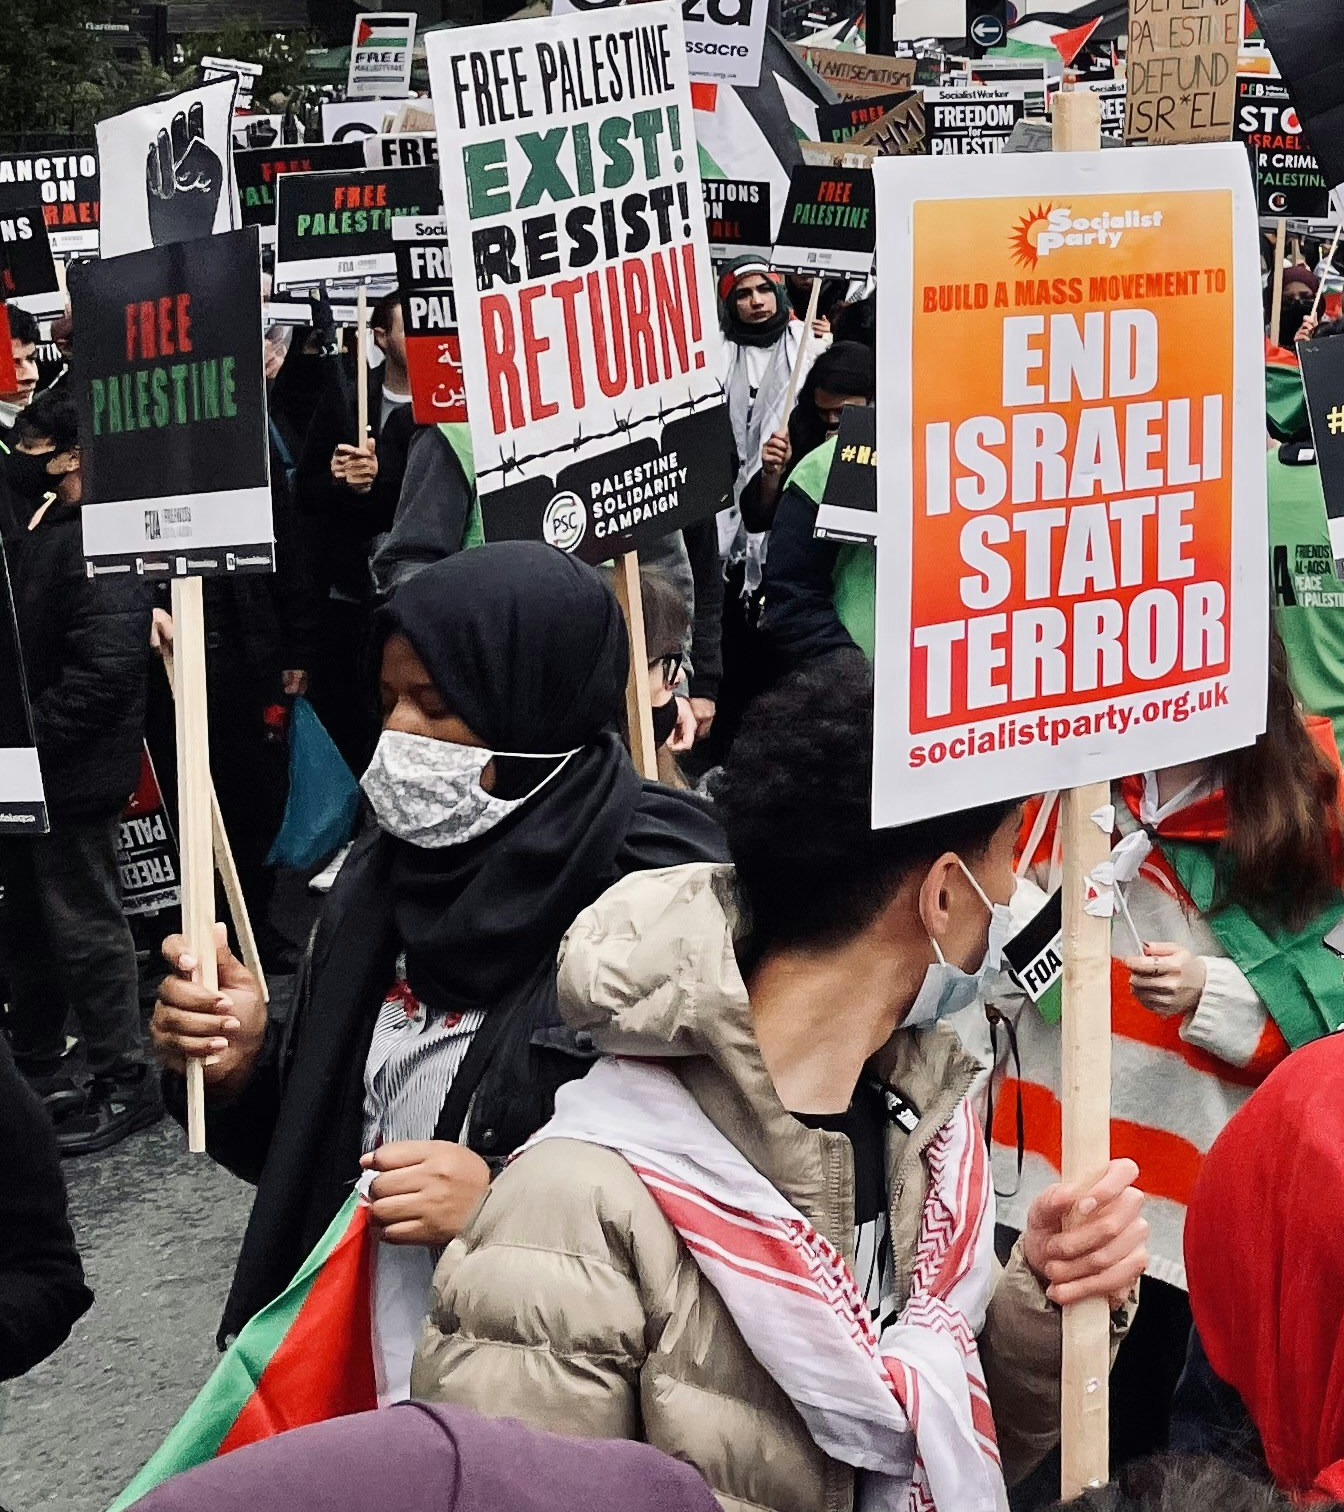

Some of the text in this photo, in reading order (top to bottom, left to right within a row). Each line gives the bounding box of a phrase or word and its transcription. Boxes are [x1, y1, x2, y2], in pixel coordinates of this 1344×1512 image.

[354, 51, 405, 64] FREE
[685, 40, 749, 57] ssacre
[450, 23, 676, 130] FREE PALESTINE
[1131, 52, 1230, 96] DEFUND
[939, 90, 1010, 100] Socialist Worker
[1240, 83, 1264, 97] PFB
[933, 104, 1014, 129] FREEDOM
[967, 126, 982, 138] for
[1238, 104, 1303, 135] STO
[382, 138, 438, 168] FRE
[931, 137, 1012, 155] PALESTIN
[0, 154, 96, 184] ANCTIO
[461, 104, 685, 221] EXIST!
[40, 179, 77, 204] ON
[333, 184, 388, 210] FREE
[701, 183, 760, 204] CTIONS
[817, 181, 853, 204] FREE
[415, 222, 449, 237] Soci
[792, 203, 870, 229] PALESTINE
[1046, 208, 1164, 234] Socialist
[471, 181, 692, 291] RESIST!
[922, 267, 1227, 314] BUILD A MASS MOVEMENT TO
[124, 292, 193, 362] FREE
[409, 295, 459, 330] PAL
[479, 242, 706, 436] RETURN!
[1001, 307, 1160, 408] END
[89, 355, 238, 437] PALESTINE
[924, 393, 1225, 517] ISRAELI
[590, 451, 678, 499] PALESTINE
[592, 466, 688, 520] SOLIDARITY
[552, 508, 577, 533] PSC
[593, 490, 680, 539] CAMPAIGN
[958, 490, 1196, 611] STATE
[1294, 575, 1323, 591] PEACE
[912, 580, 1227, 720] TERROR
[908, 681, 1230, 769] socialistparty.org.uk
[1023, 948, 1063, 994] FOA
